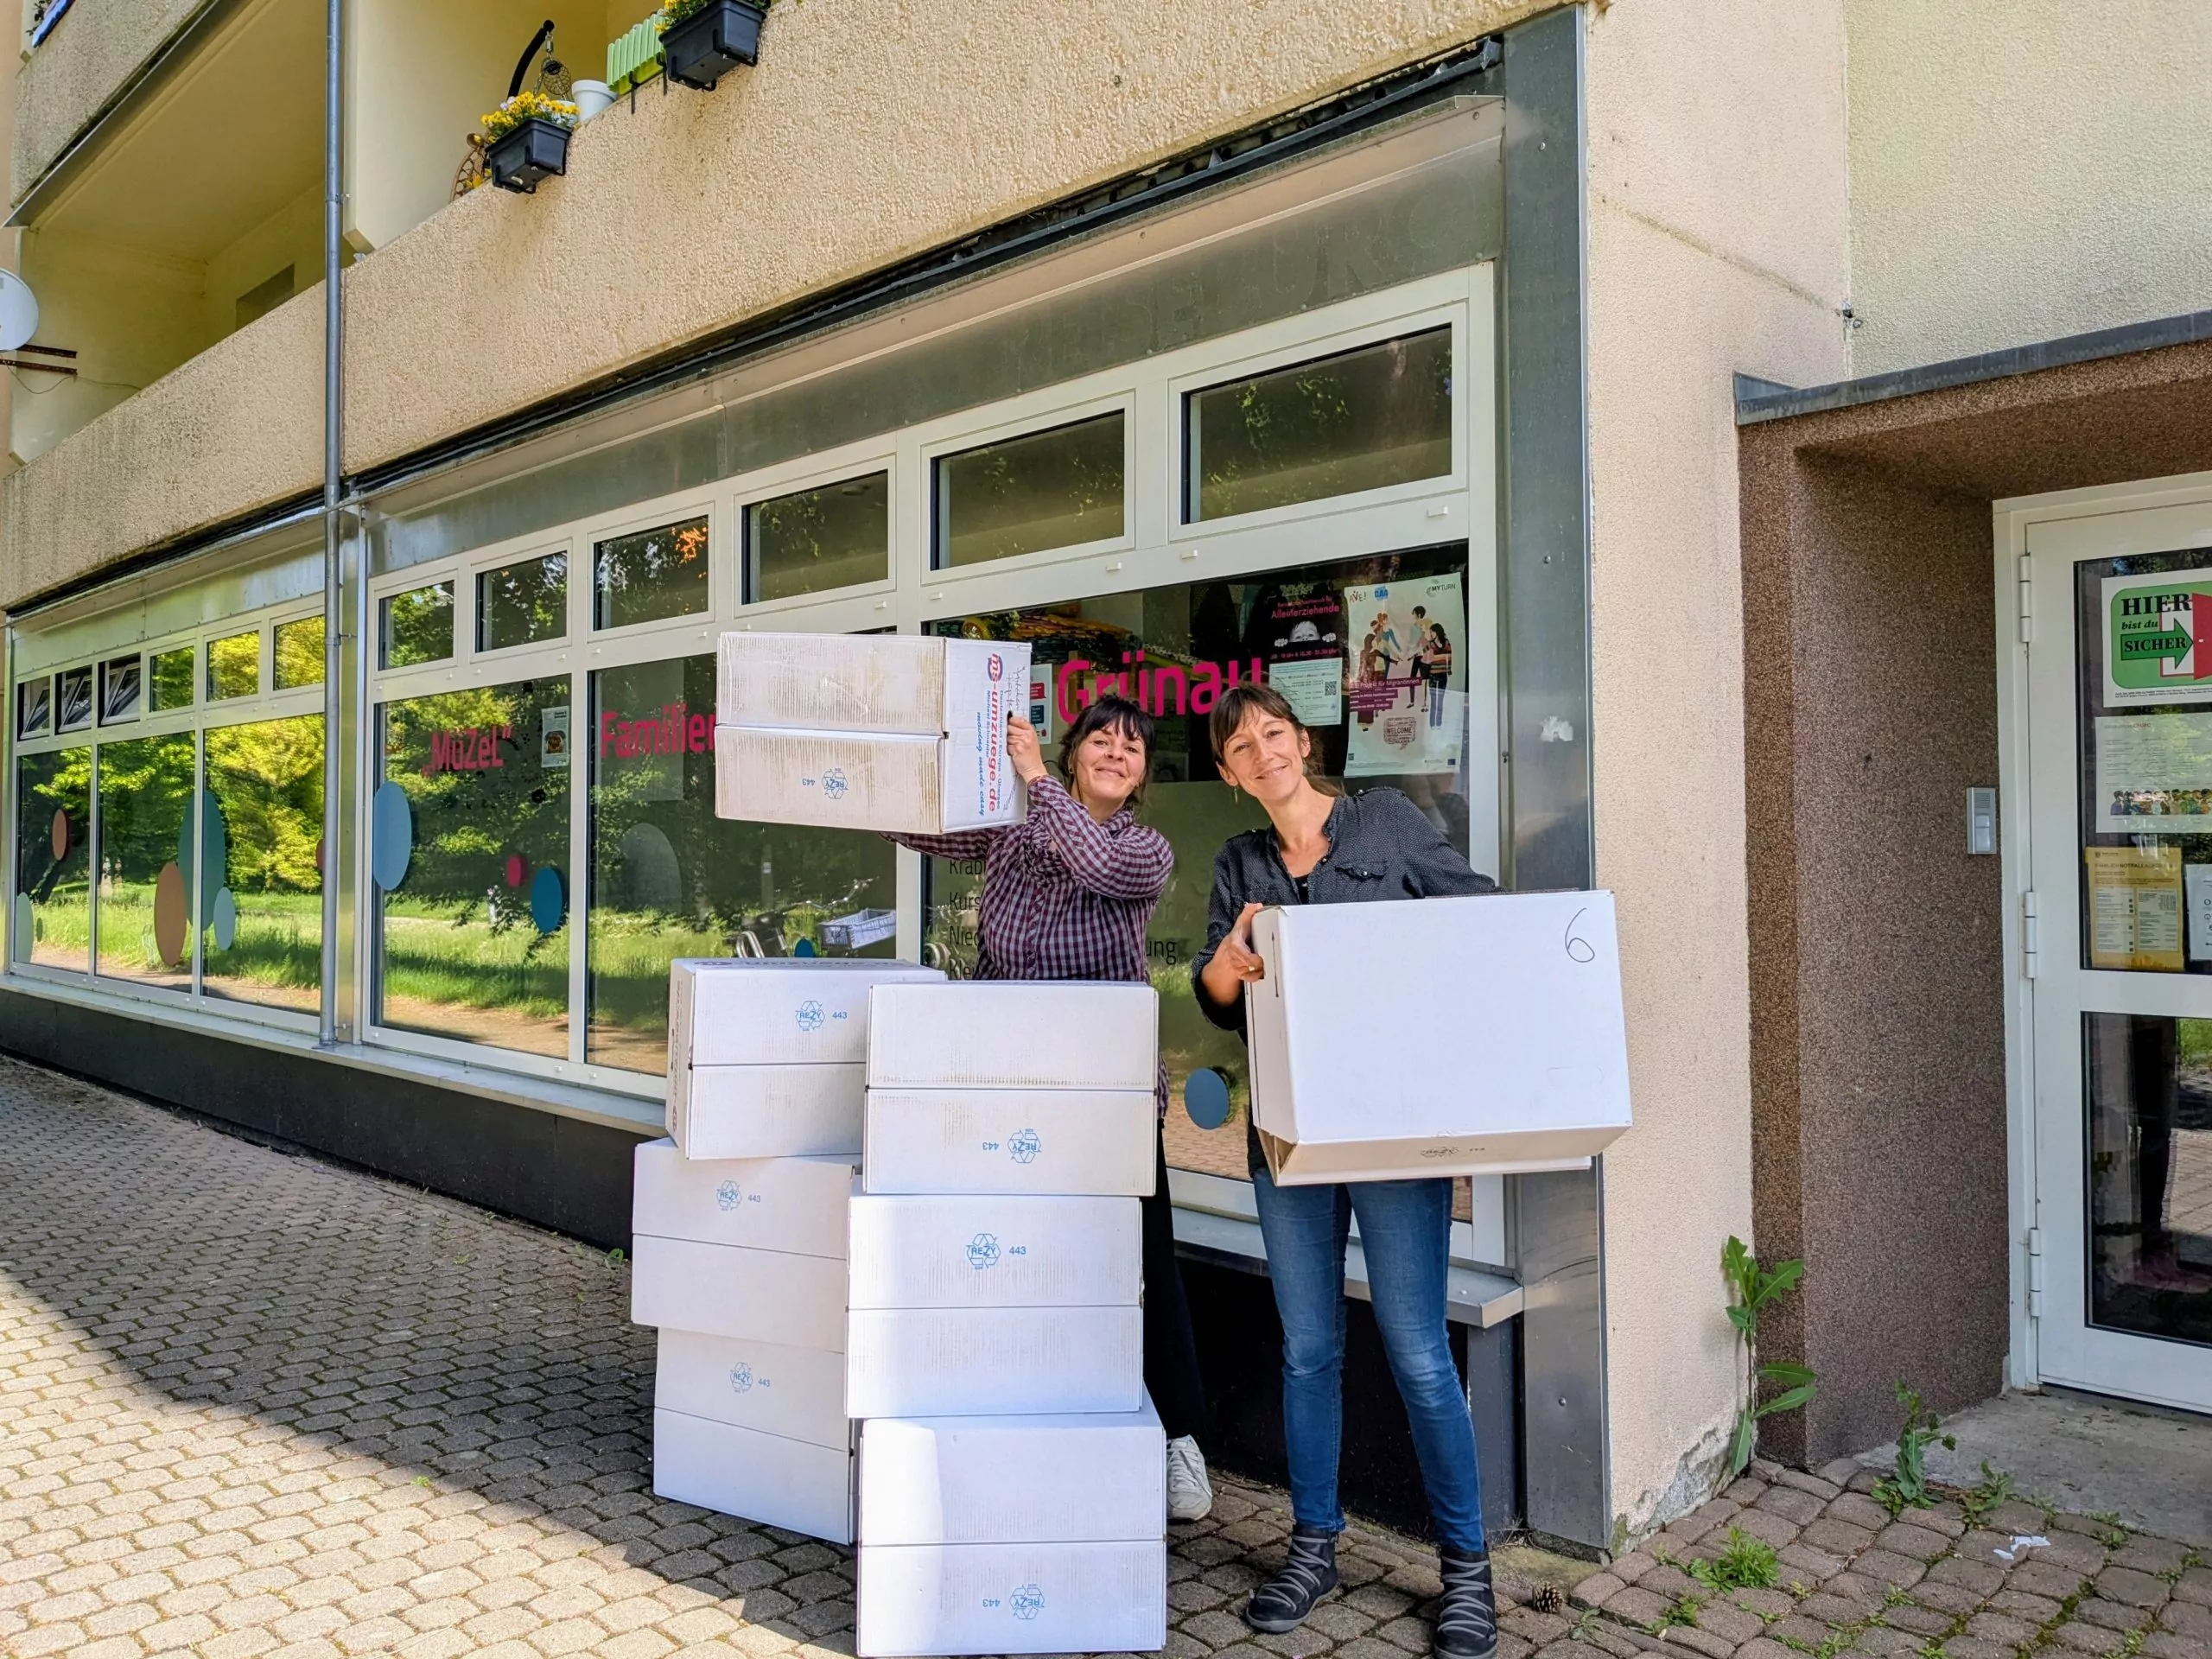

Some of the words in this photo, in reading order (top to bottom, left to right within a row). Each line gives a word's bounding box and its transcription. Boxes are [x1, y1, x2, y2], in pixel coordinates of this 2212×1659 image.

[2121, 593, 2192, 616] HIER
[2121, 620, 2142, 630] bist
[2144, 620, 2158, 628] du
[2124, 637, 2187, 652] SICHER
[988, 653, 1001, 812] ms-umzuege.de
[950, 860, 987, 875] Krab
[1565, 907, 1596, 963] 6
[832, 1011, 848, 1020] 443
[982, 1141, 1000, 1151] 443
[747, 1194, 761, 1203] 443
[1008, 1246, 1027, 1255] 443
[758, 1378, 771, 1388] 443
[982, 1599, 1001, 1607] 443
